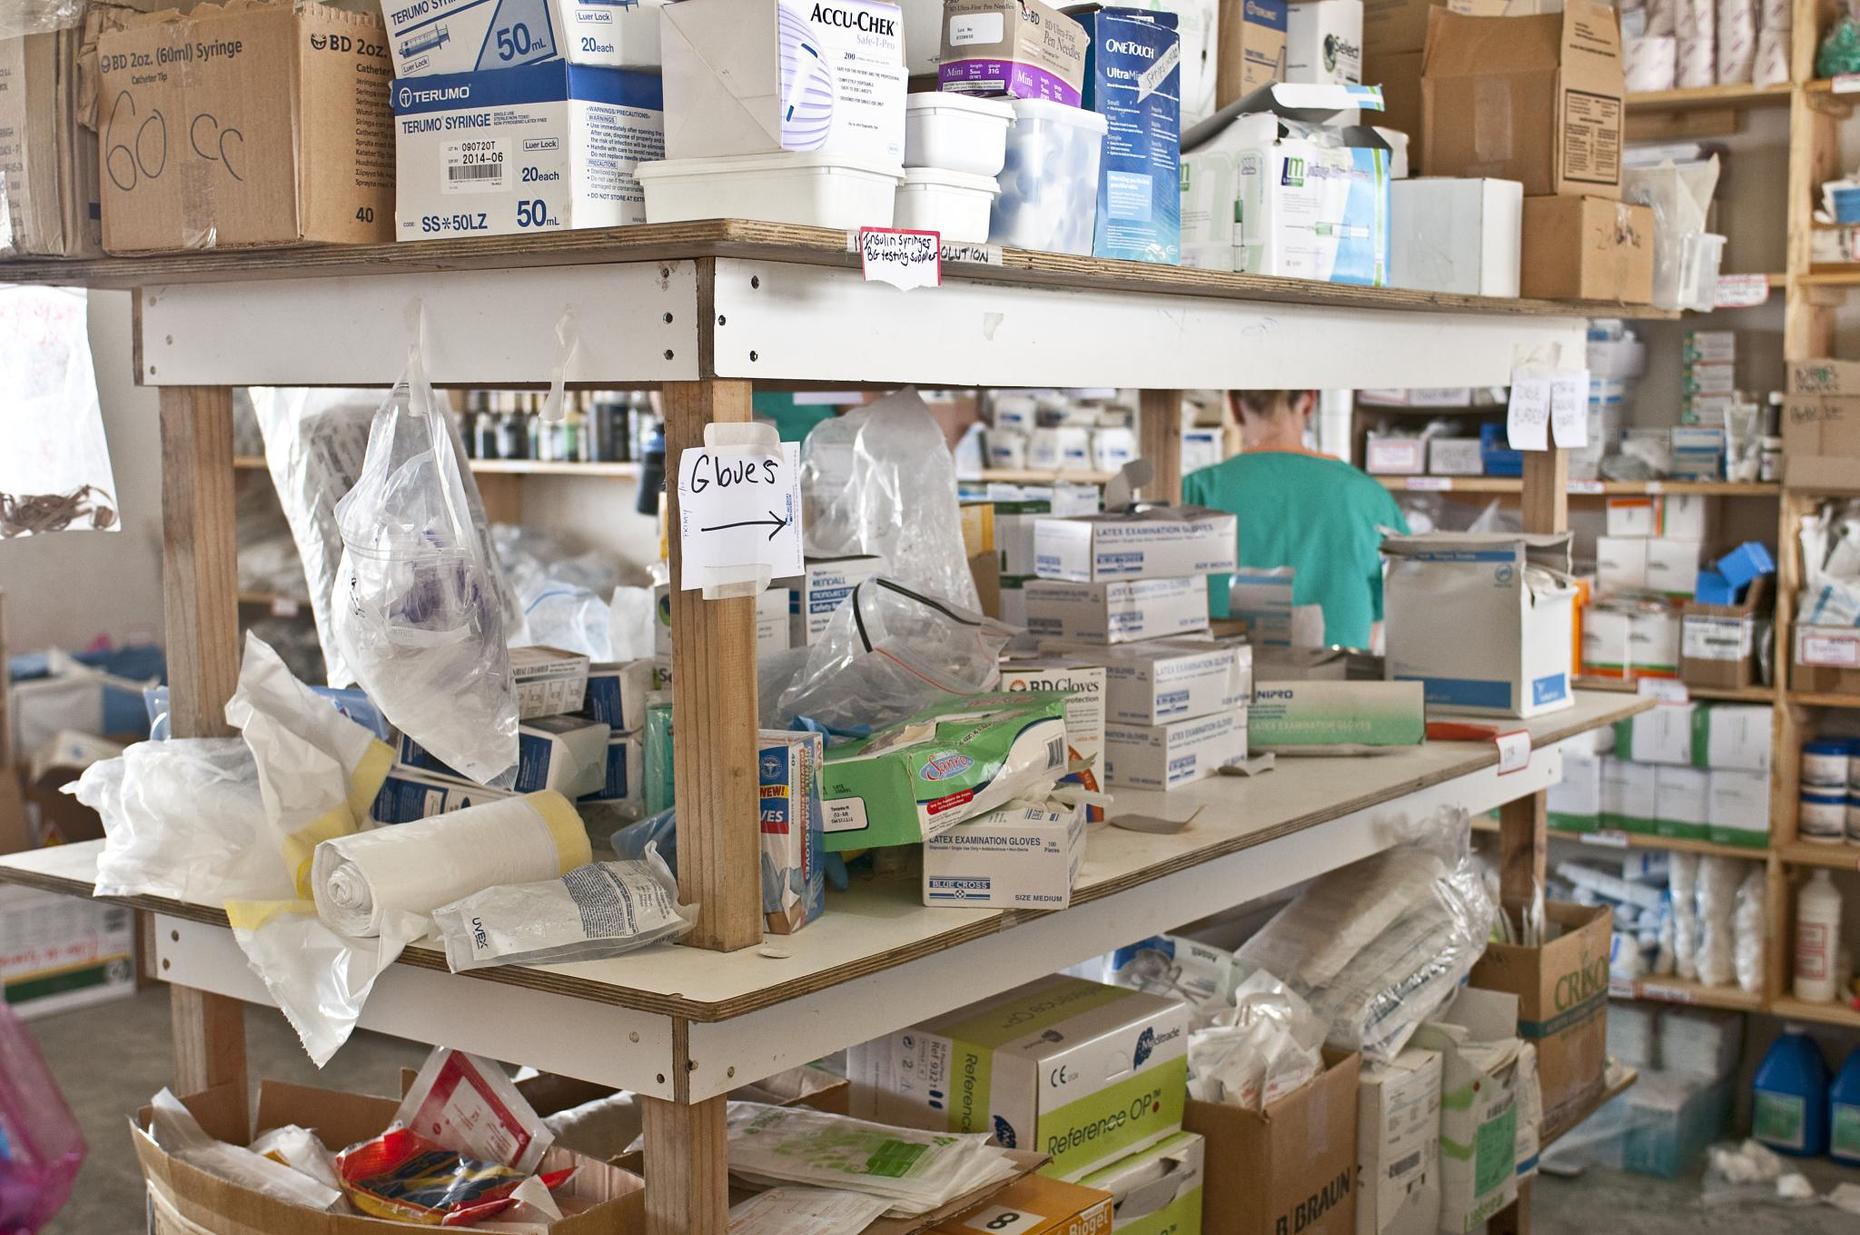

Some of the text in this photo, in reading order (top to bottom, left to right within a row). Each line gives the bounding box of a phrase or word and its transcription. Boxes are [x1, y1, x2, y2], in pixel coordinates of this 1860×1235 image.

[391, 1, 429, 26] TERUMO
[577, 12, 610, 22] Luer Lock
[811, 3, 895, 37] ACCU-CHEK
[1030, 10, 1040, 25] BD
[329, 34, 388, 58] BD 2oz.
[1043, 31, 1057, 47] Pen
[1057, 37, 1081, 60] Needles
[1334, 35, 1359, 60] Select
[112, 39, 242, 70] BD 2oz. (60ml) Syringe
[844, 52, 856, 60] 200
[356, 63, 391, 76] Catheter
[946, 67, 963, 77] Mini
[131, 72, 167, 85] Catheter Tip
[1017, 70, 1033, 87] Mini
[413, 86, 470, 103] TERUMO
[402, 113, 491, 134] TERUMO SYRINGE
[105, 90, 167, 191] 60
[540, 139, 557, 148] Lock
[463, 152, 503, 164] 2014-06
[356, 207, 374, 223] 40
[864, 232, 896, 250] Insulin
[881, 250, 909, 266] testing
[941, 246, 989, 262] OLUTION
[1096, 529, 1123, 537] LATEX
[1125, 526, 1180, 536] EXAMINATION
[1055, 678, 1099, 693] Gloves
[1065, 696, 1099, 704] rotection
[1257, 689, 1294, 699] NIPRO
[955, 835, 1007, 845] EXAMINATION
[1009, 836, 1041, 846] GLOVES
[932, 879, 988, 889] BLUE CROSS
[1032, 894, 1063, 902] MEDIUM
[472, 917, 488, 949] UVEX
[1047, 1110, 1126, 1156] Reference
[1294, 1166, 1350, 1234] BRAUN
[986, 1212, 1020, 1230] 8
[1069, 1207, 1108, 1235] Biogel
